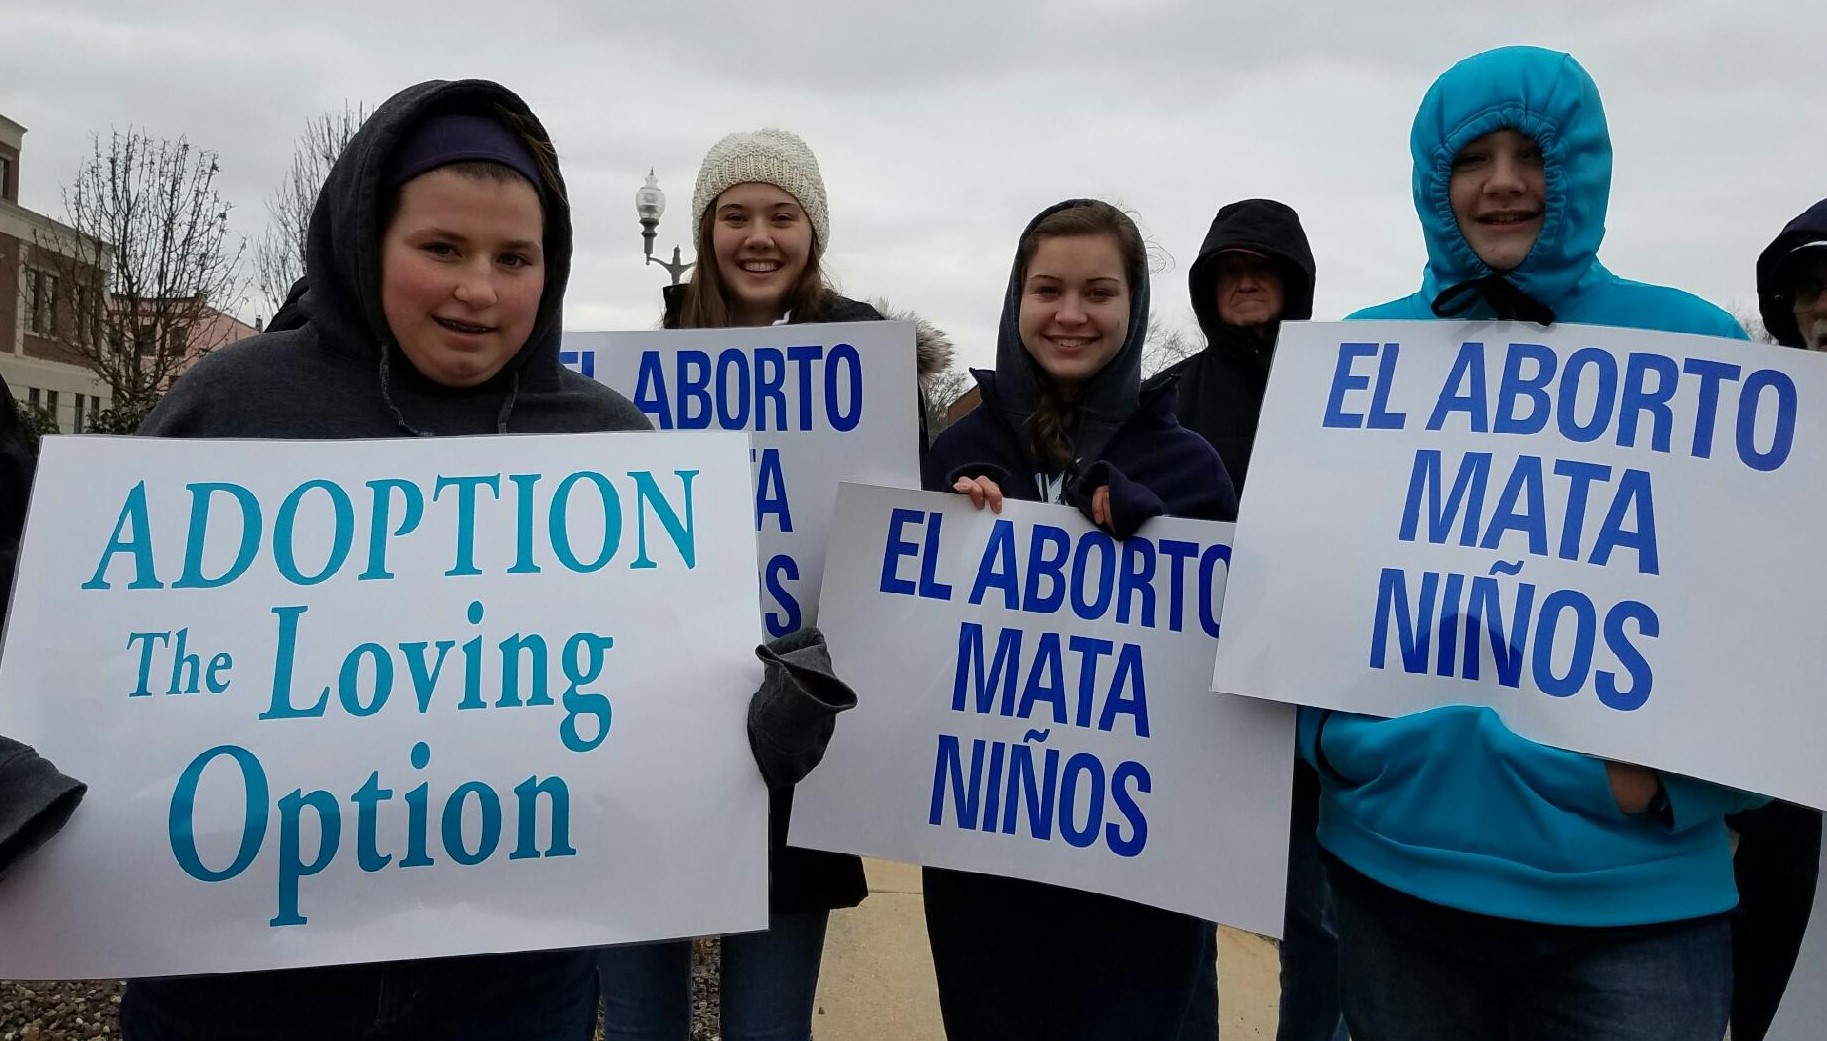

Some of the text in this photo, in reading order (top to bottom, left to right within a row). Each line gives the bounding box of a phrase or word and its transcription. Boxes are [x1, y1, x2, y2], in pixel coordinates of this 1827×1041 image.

[633, 343, 863, 433] ABORTO
[1322, 342, 1798, 472] EL ABORTO
[81, 469, 700, 590] ADOPTION
[879, 508, 953, 601] EL
[1398, 449, 1660, 576] MATA
[127, 600, 614, 753] The Loving
[951, 621, 1151, 739] MATA
[1368, 560, 1661, 712] NIÑOS
[168, 741, 577, 928] Option
[928, 728, 1152, 858] NIÑOS
